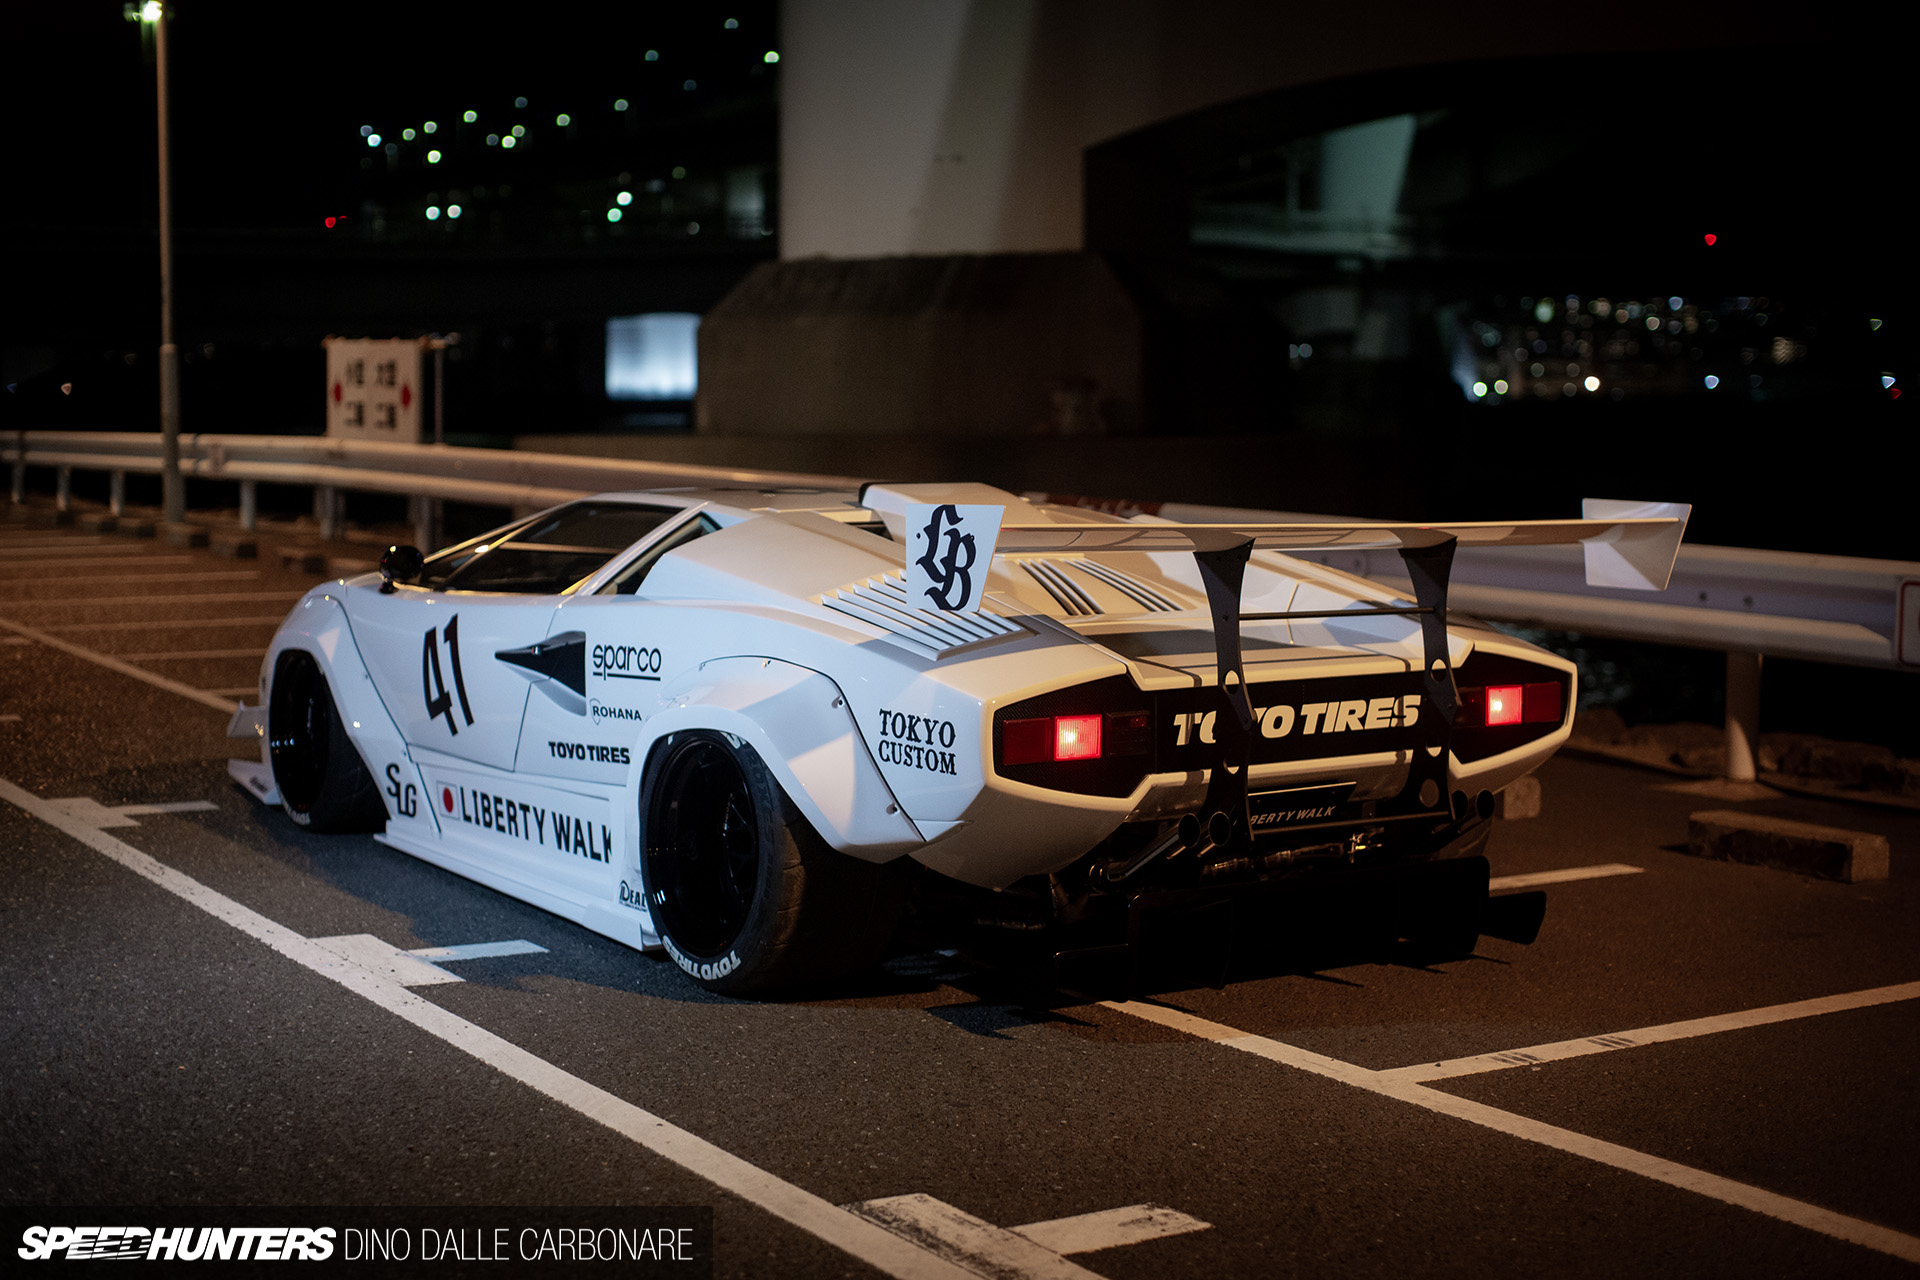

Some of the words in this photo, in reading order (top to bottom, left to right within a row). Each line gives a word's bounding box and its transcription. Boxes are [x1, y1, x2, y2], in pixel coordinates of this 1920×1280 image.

[422, 613, 475, 737] 41
[592, 644, 662, 681] sparco
[592, 705, 642, 722] ROHANA
[879, 708, 957, 749] TOKYO
[1300, 694, 1422, 735] TIRES
[548, 740, 586, 761] TOYO
[587, 743, 631, 765] TIRES
[878, 739, 957, 776] CUSTOM
[460, 786, 546, 846] LIBERTY
[551, 811, 613, 864] WALK
[1250, 810, 1296, 825] BERTY
[1296, 805, 1337, 820] WALK
[661, 934, 701, 979] TIRES
[700, 950, 742, 981] TOYO
